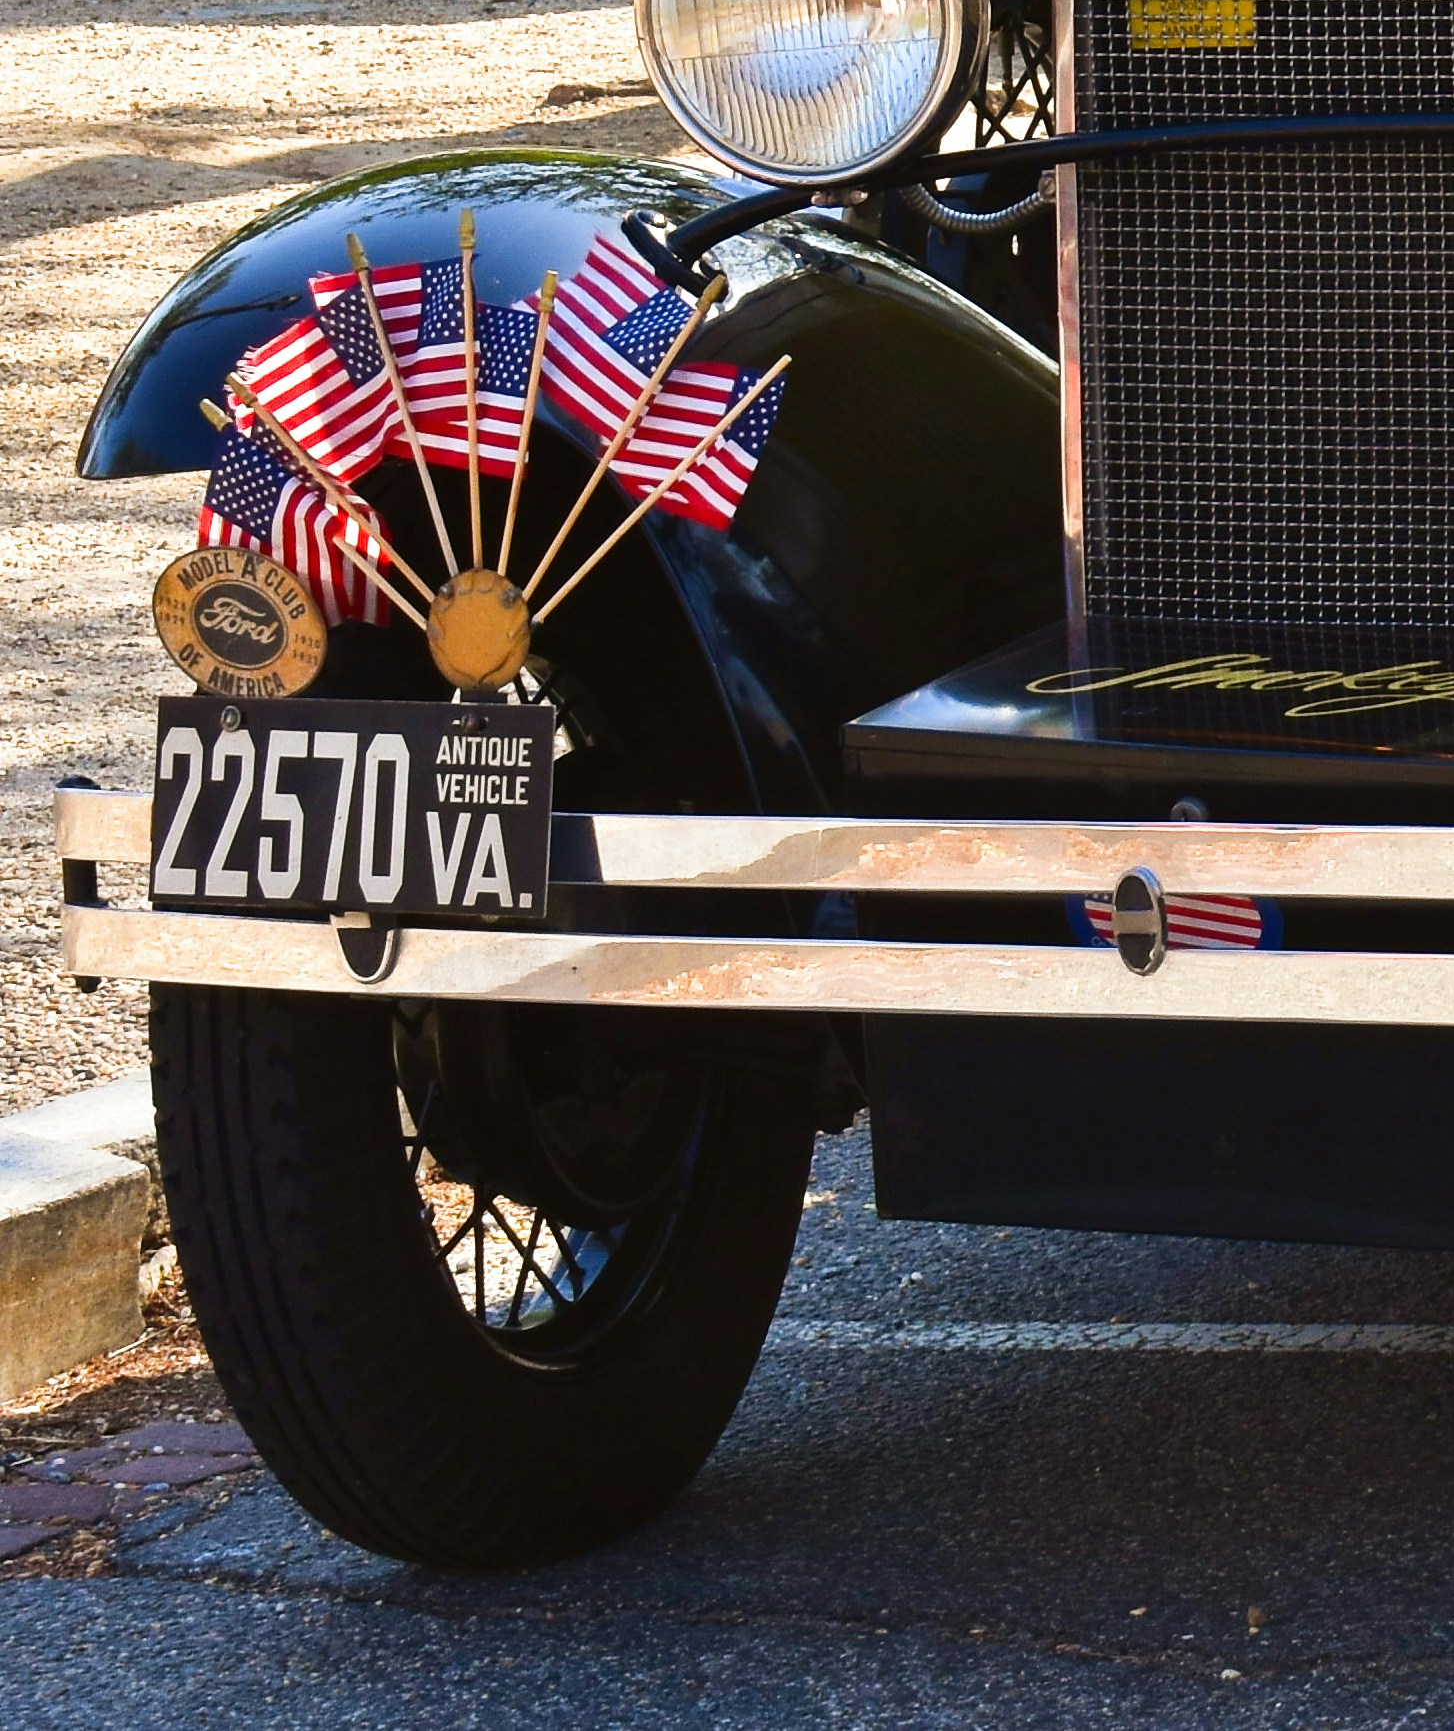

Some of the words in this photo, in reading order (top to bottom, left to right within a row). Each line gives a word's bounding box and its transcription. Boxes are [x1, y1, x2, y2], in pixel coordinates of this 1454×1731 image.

[177, 552, 235, 592] MODEL
[264, 567, 307, 620] CLUB
[200, 597, 280, 644] Ford
[178, 642, 204, 668] OF
[207, 665, 287, 698] AMERICA
[436, 735, 533, 768] ANTIQUE
[153, 726, 411, 904] 22570
[436, 773, 530, 806] VEHICLE
[425, 810, 533, 909] VA.
